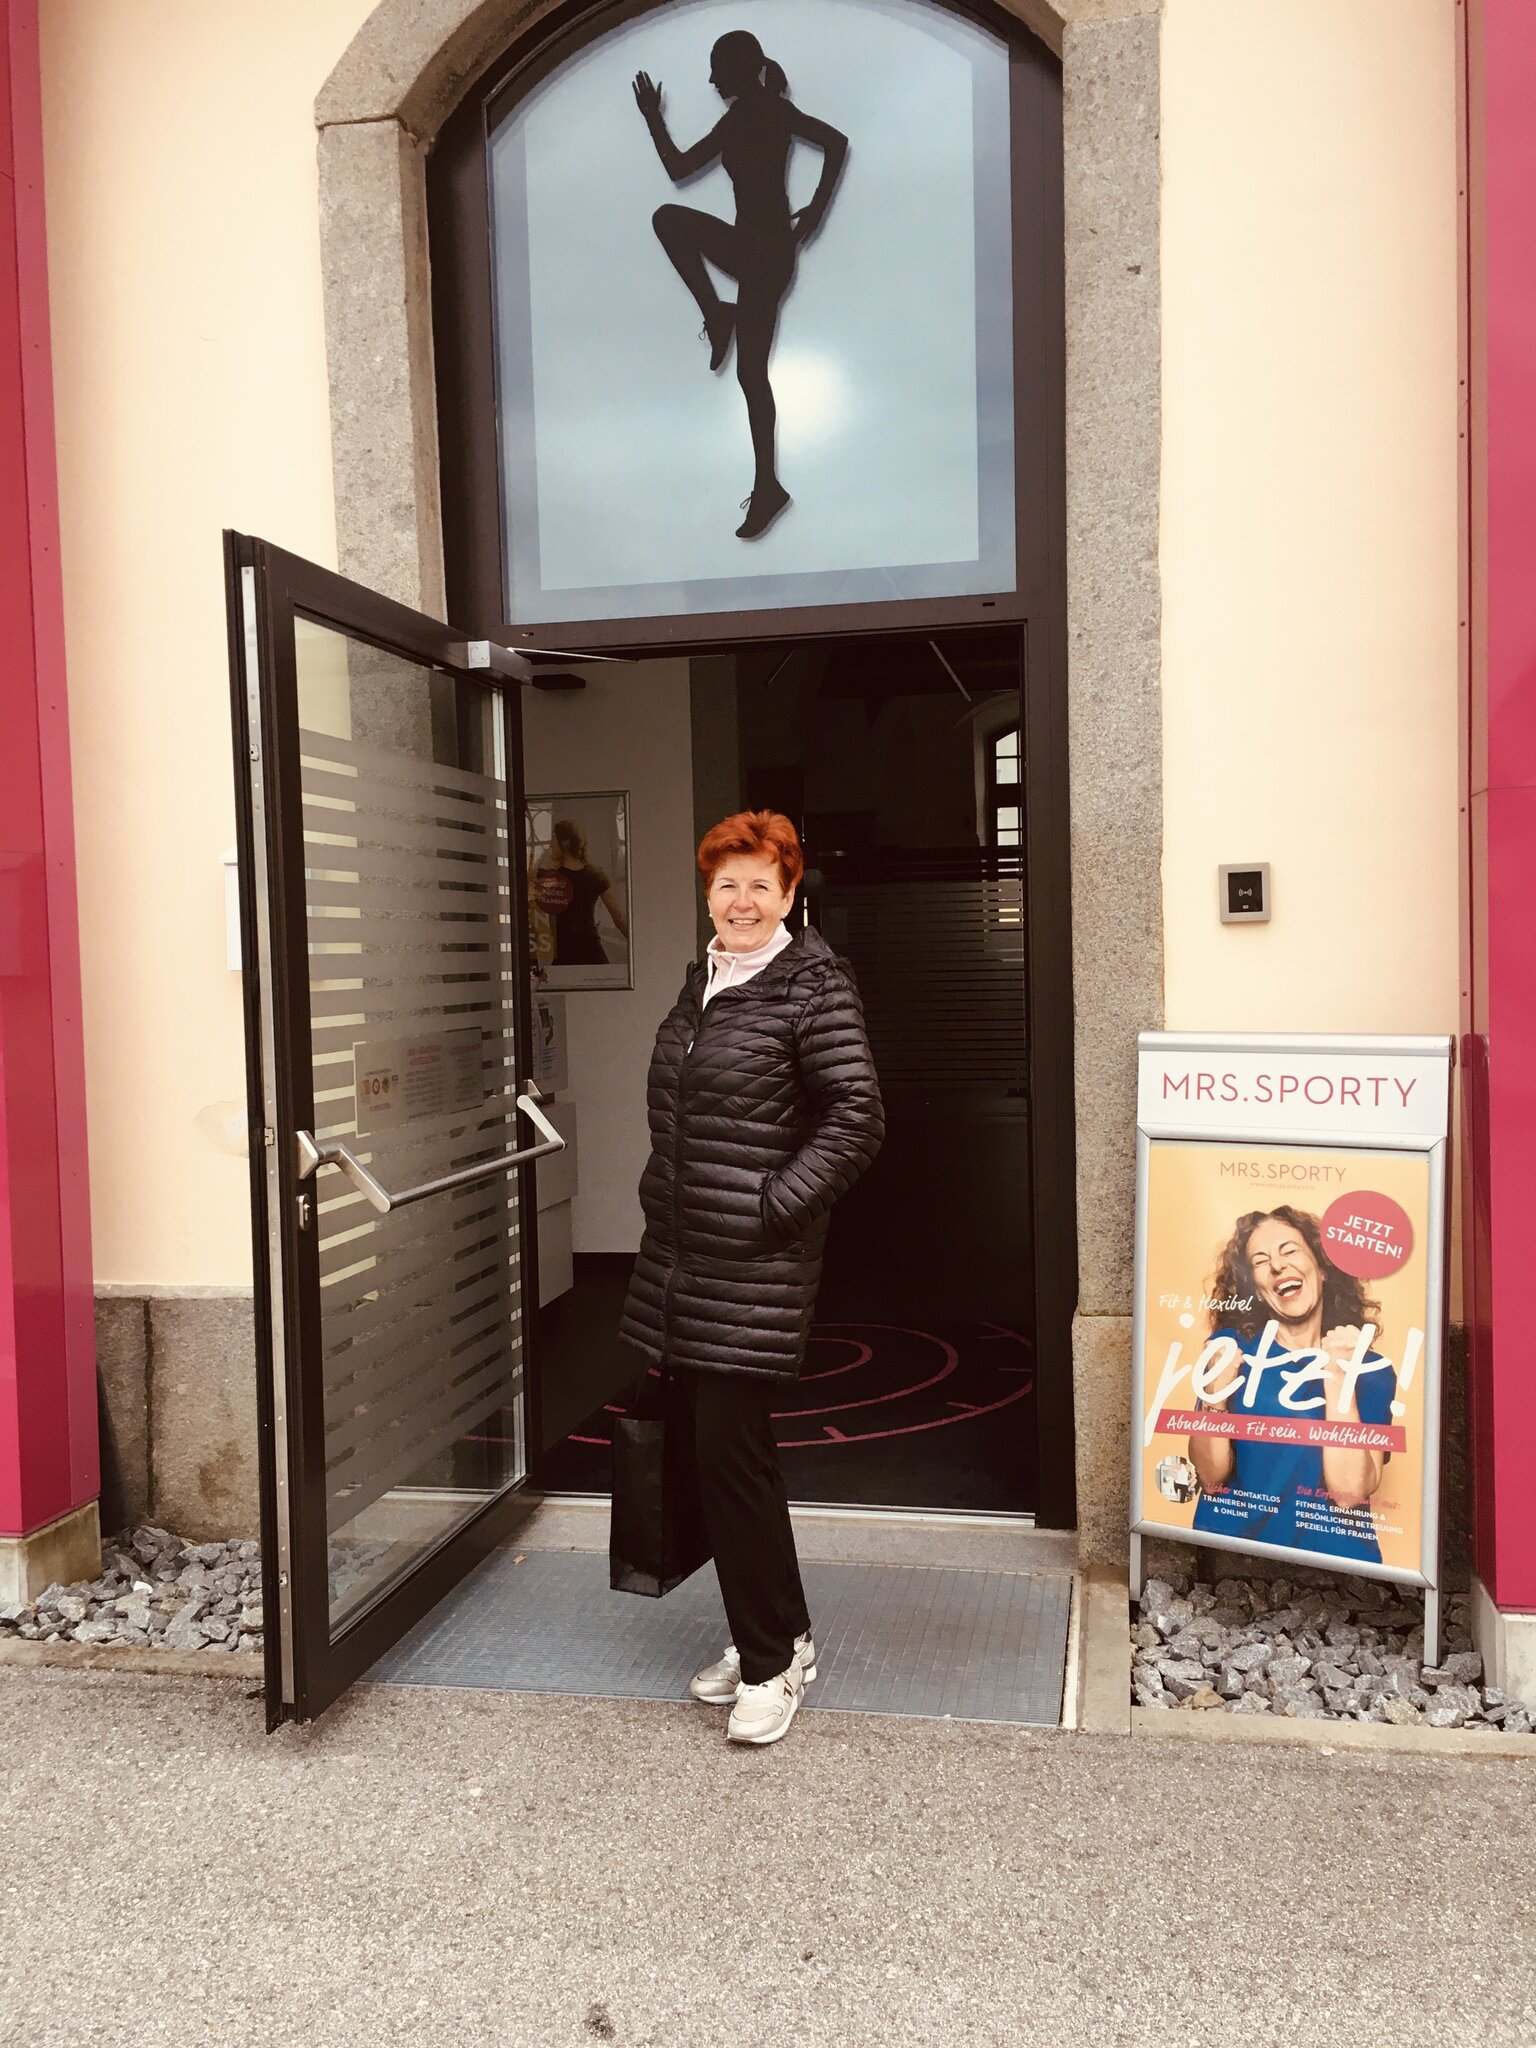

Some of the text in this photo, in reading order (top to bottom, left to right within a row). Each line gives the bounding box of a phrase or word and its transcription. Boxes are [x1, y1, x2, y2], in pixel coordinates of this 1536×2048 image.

[1162, 1071, 1418, 1108] MRS.SPORTY
[1219, 1161, 1348, 1183] MRS.SPORTY
[1343, 1214, 1394, 1238] JETZT
[1326, 1226, 1403, 1259] STARTEN!
[1159, 1293, 1254, 1313] Fit & flexibel
[1143, 1312, 1425, 1448] jetzt!
[1166, 1414, 1394, 1447] Abnehmen. Fit sein. Wohlfühlen.
[1233, 1489, 1281, 1503] KONTAKTLOS
[1296, 1485, 1313, 1496] Die
[1203, 1494, 1246, 1508] TRAINIEREN
[1258, 1504, 1279, 1514] CLUB
[1220, 1507, 1249, 1519] ONLINE
[1295, 1500, 1386, 1521] FITNESS, ERNÄHRUNG &
[1295, 1510, 1404, 1535] PERSÖNLICHER BETREUUNG
[1295, 1520, 1379, 1541] SPEZIELL FÜR FRAUEN
